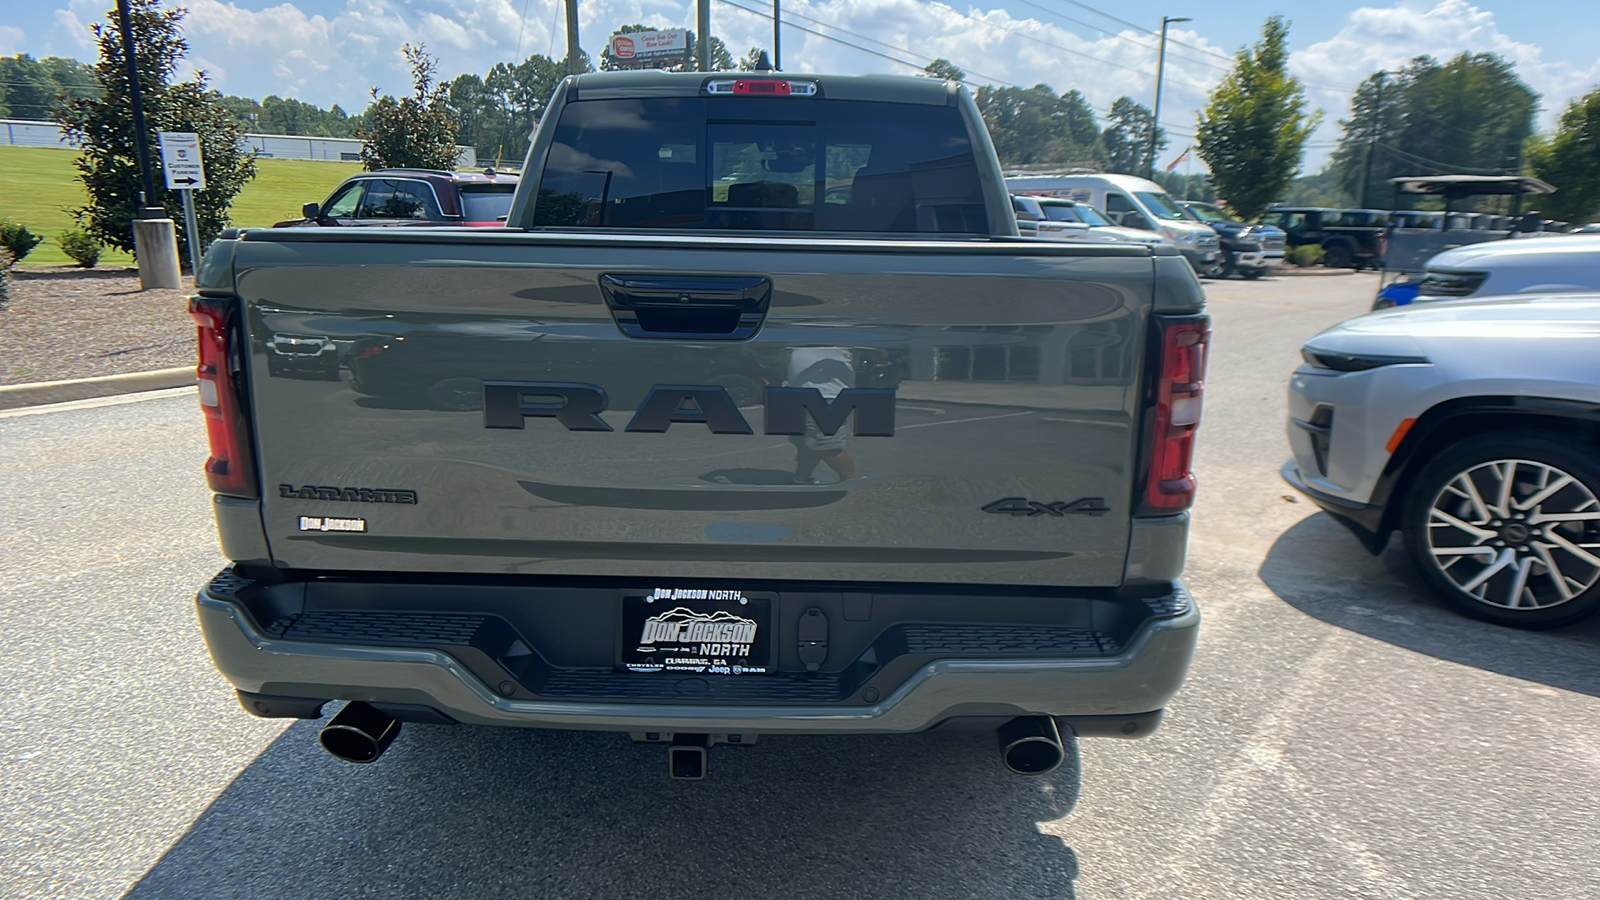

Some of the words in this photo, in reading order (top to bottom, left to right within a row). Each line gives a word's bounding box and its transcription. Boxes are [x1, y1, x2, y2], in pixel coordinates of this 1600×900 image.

[483, 379, 897, 437] RAM
[279, 483, 418, 506] LARAMIE
[708, 590, 742, 600] NORTH
[699, 643, 750, 656] NORTH
[708, 665, 731, 675] Jeep
